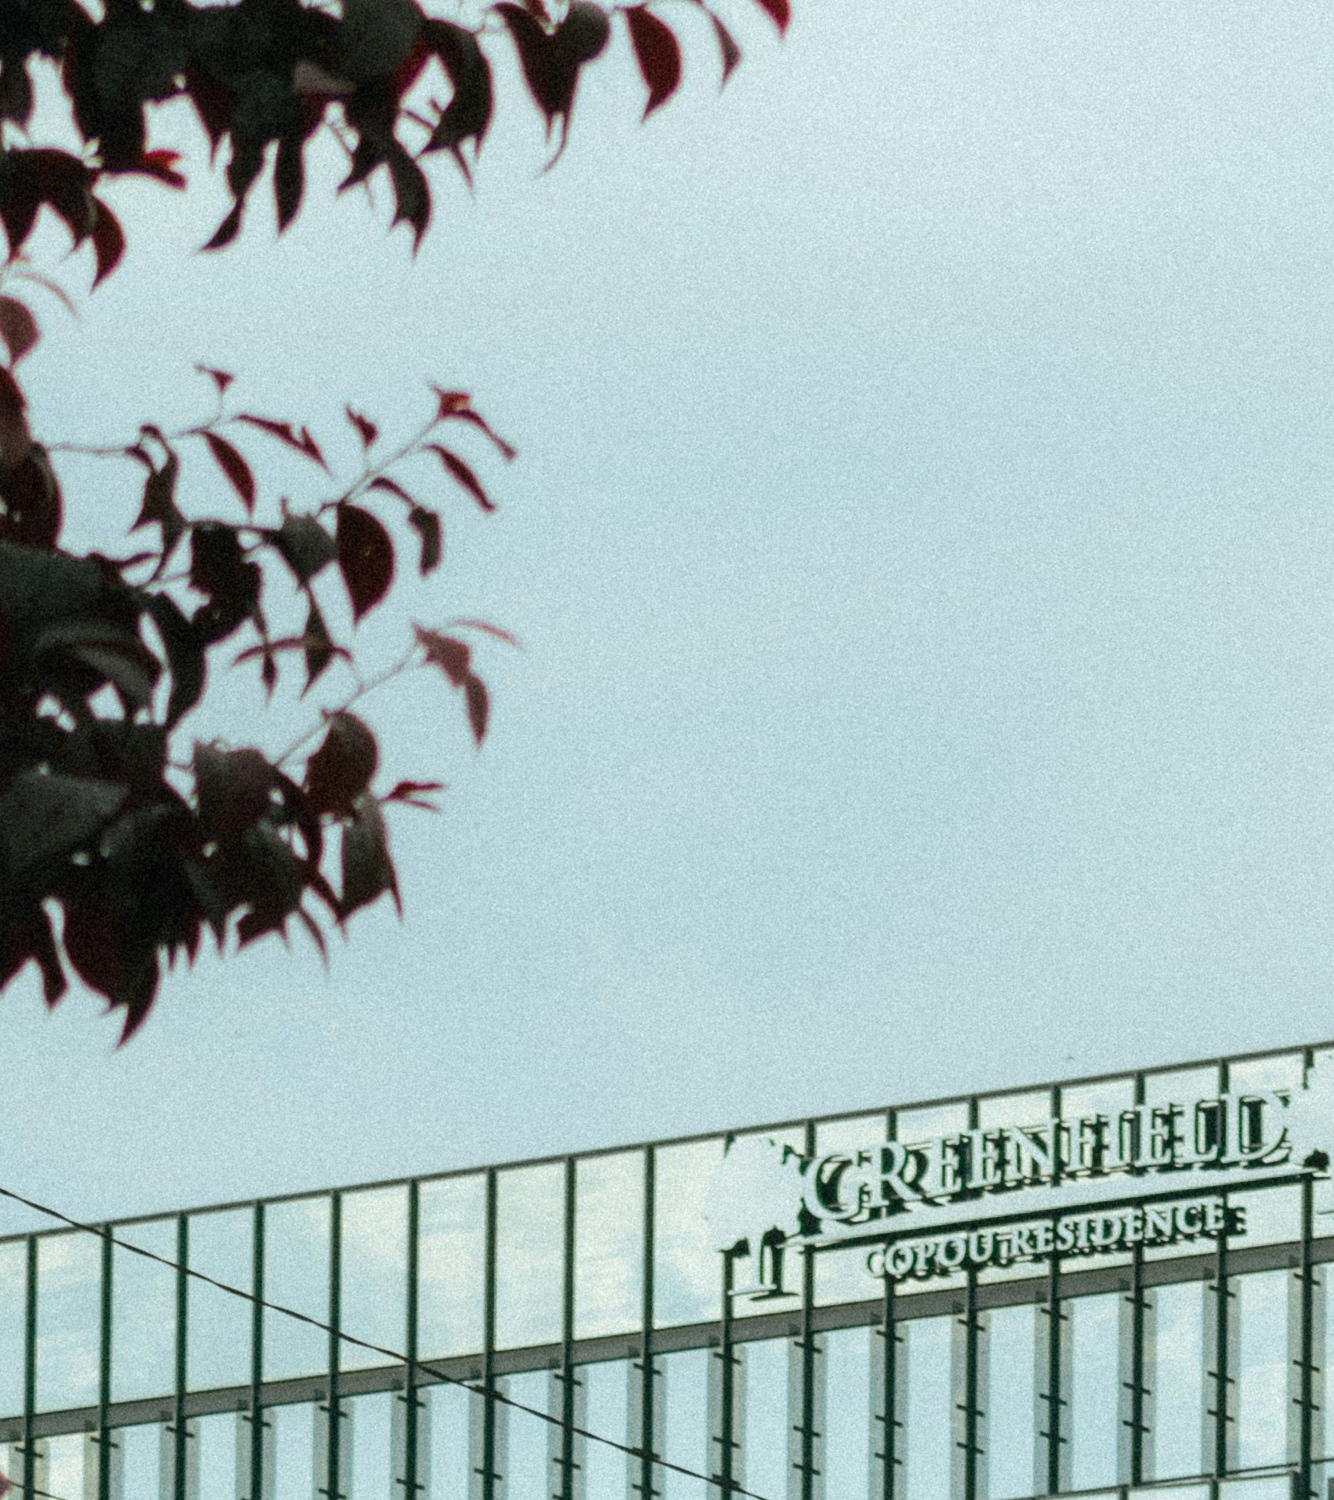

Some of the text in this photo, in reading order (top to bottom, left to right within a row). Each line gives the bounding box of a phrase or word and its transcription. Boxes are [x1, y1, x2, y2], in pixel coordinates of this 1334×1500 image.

[803, 1092, 1291, 1221] GREENFIELD
[868, 1200, 1227, 1278] COPOU RESIDENCE
